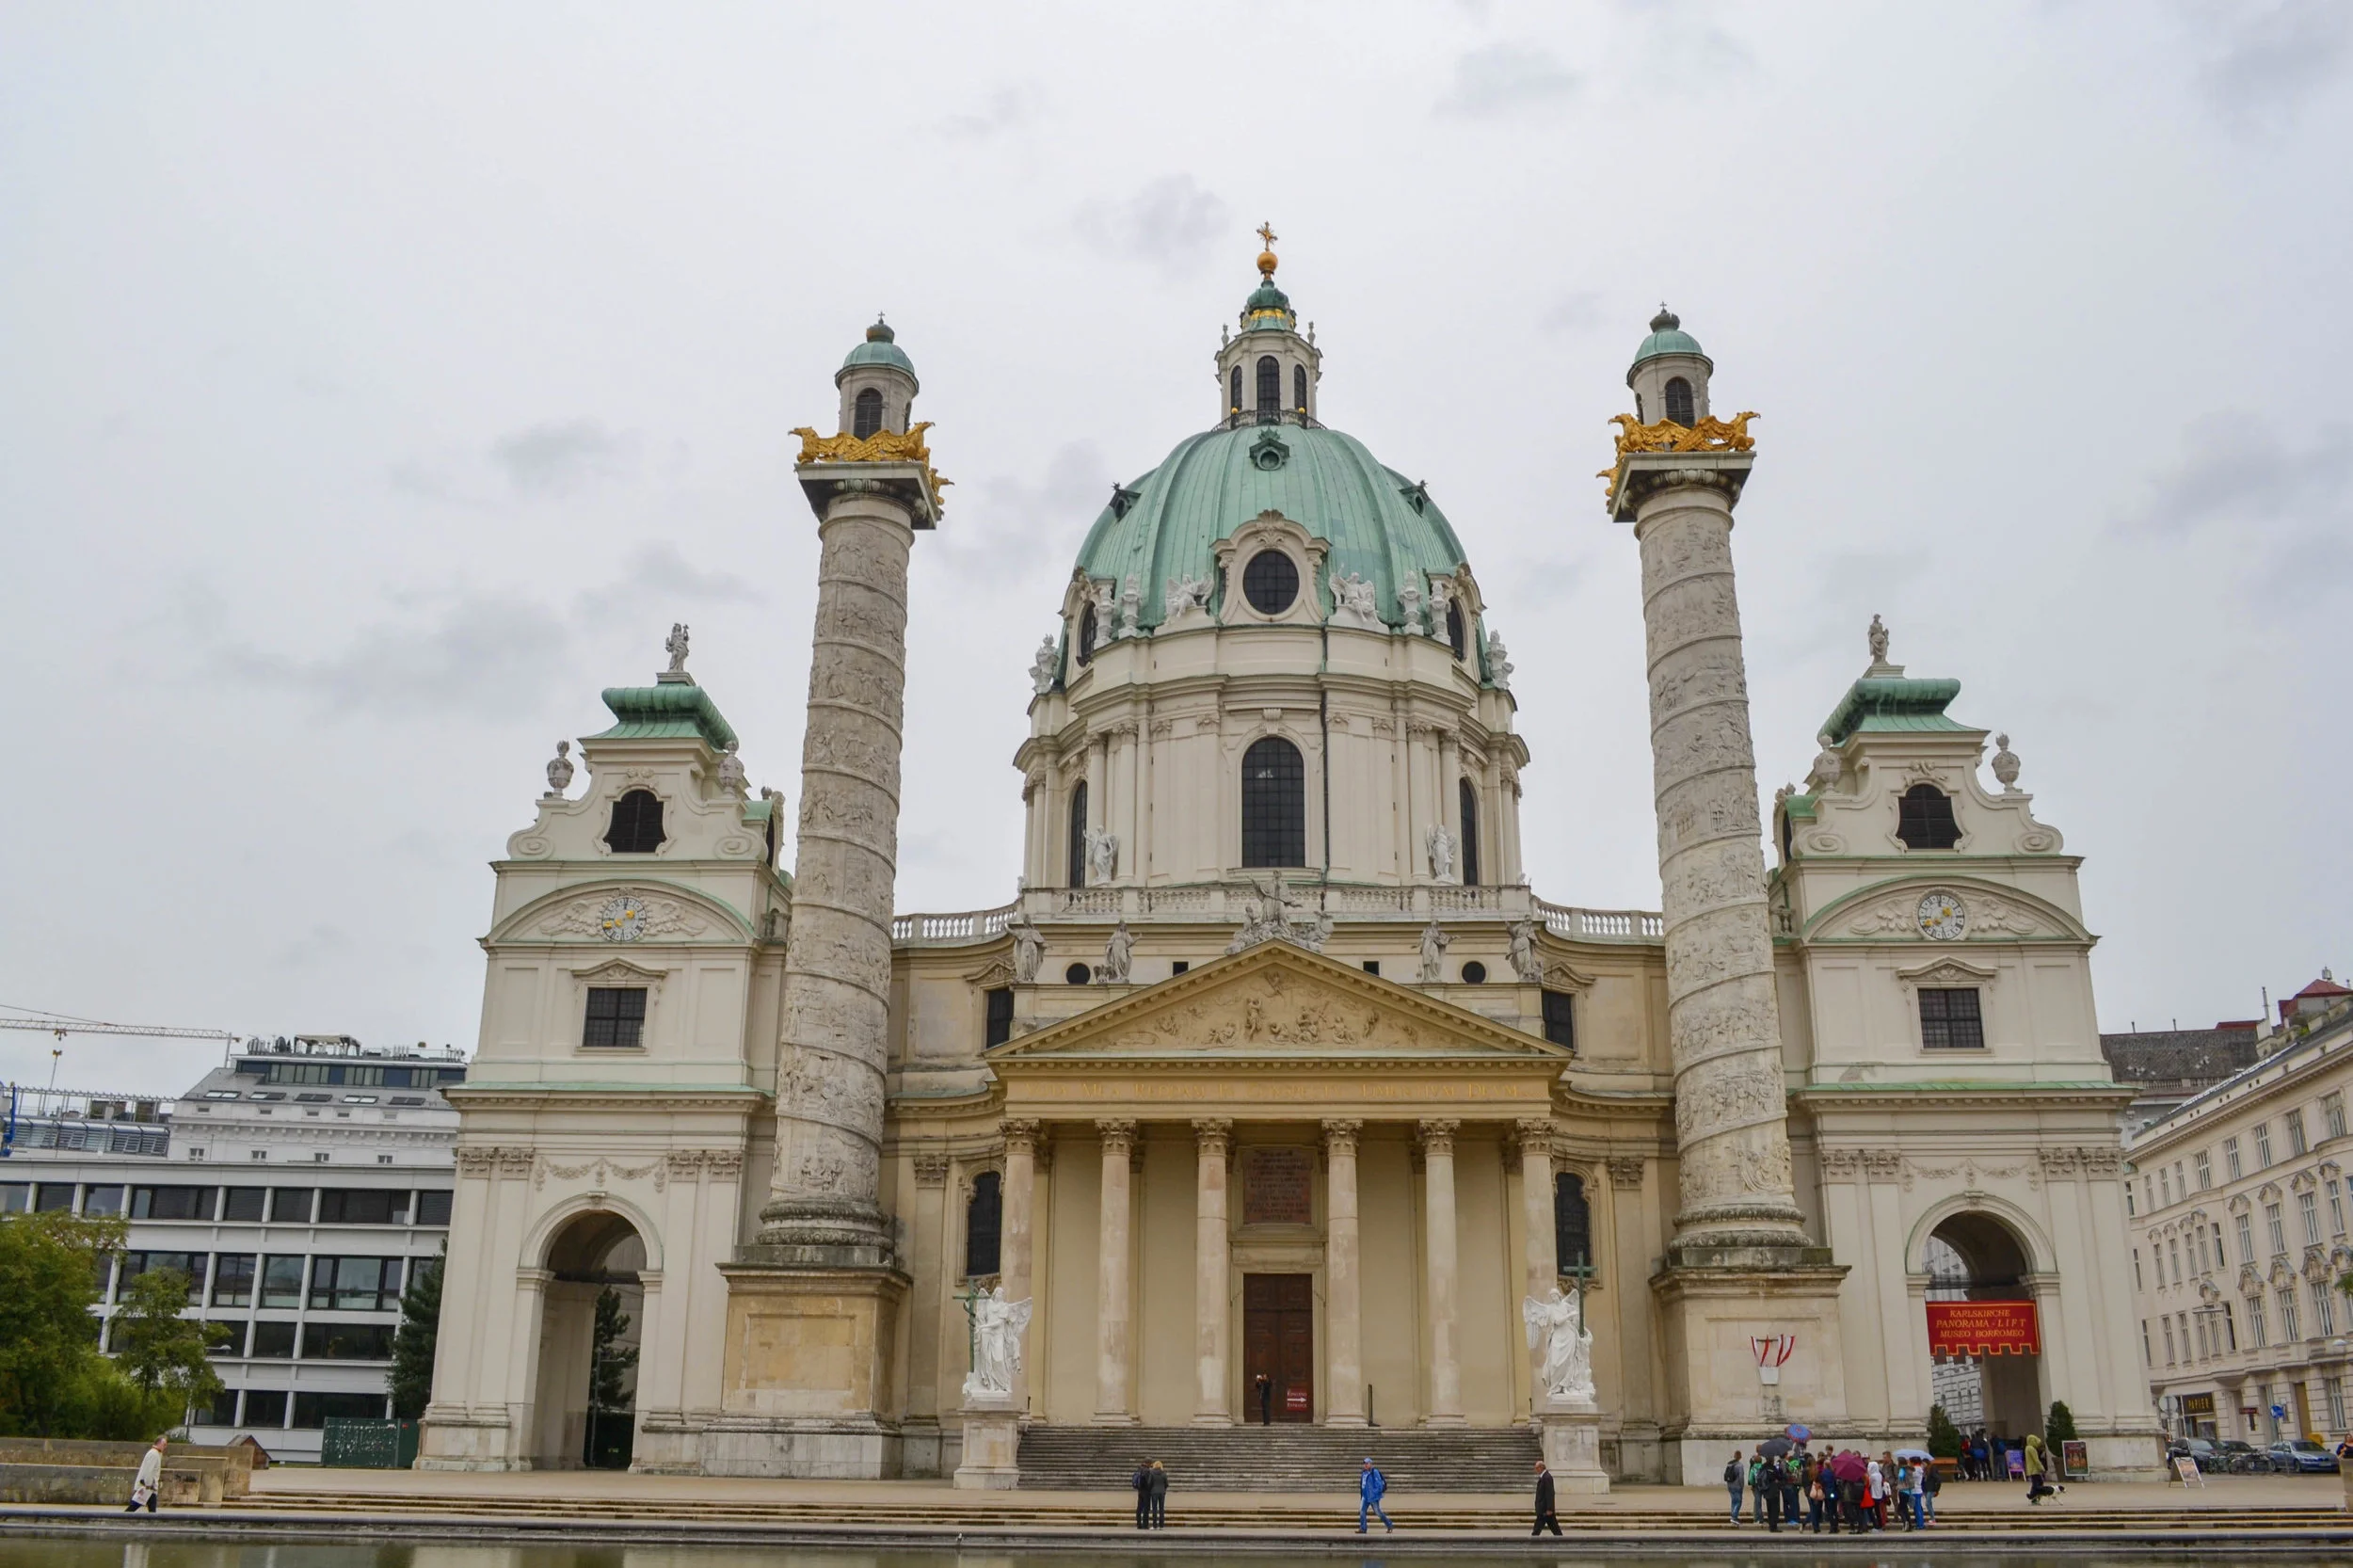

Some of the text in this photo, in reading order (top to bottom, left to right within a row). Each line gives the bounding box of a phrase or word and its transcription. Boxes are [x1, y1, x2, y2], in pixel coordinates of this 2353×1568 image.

[1950, 1309, 2011, 1318] KARLSKIRCHE
[1936, 1319, 1989, 1328] PANORAMA
[1940, 1328, 2025, 1337] MUSEO BORROMEO
